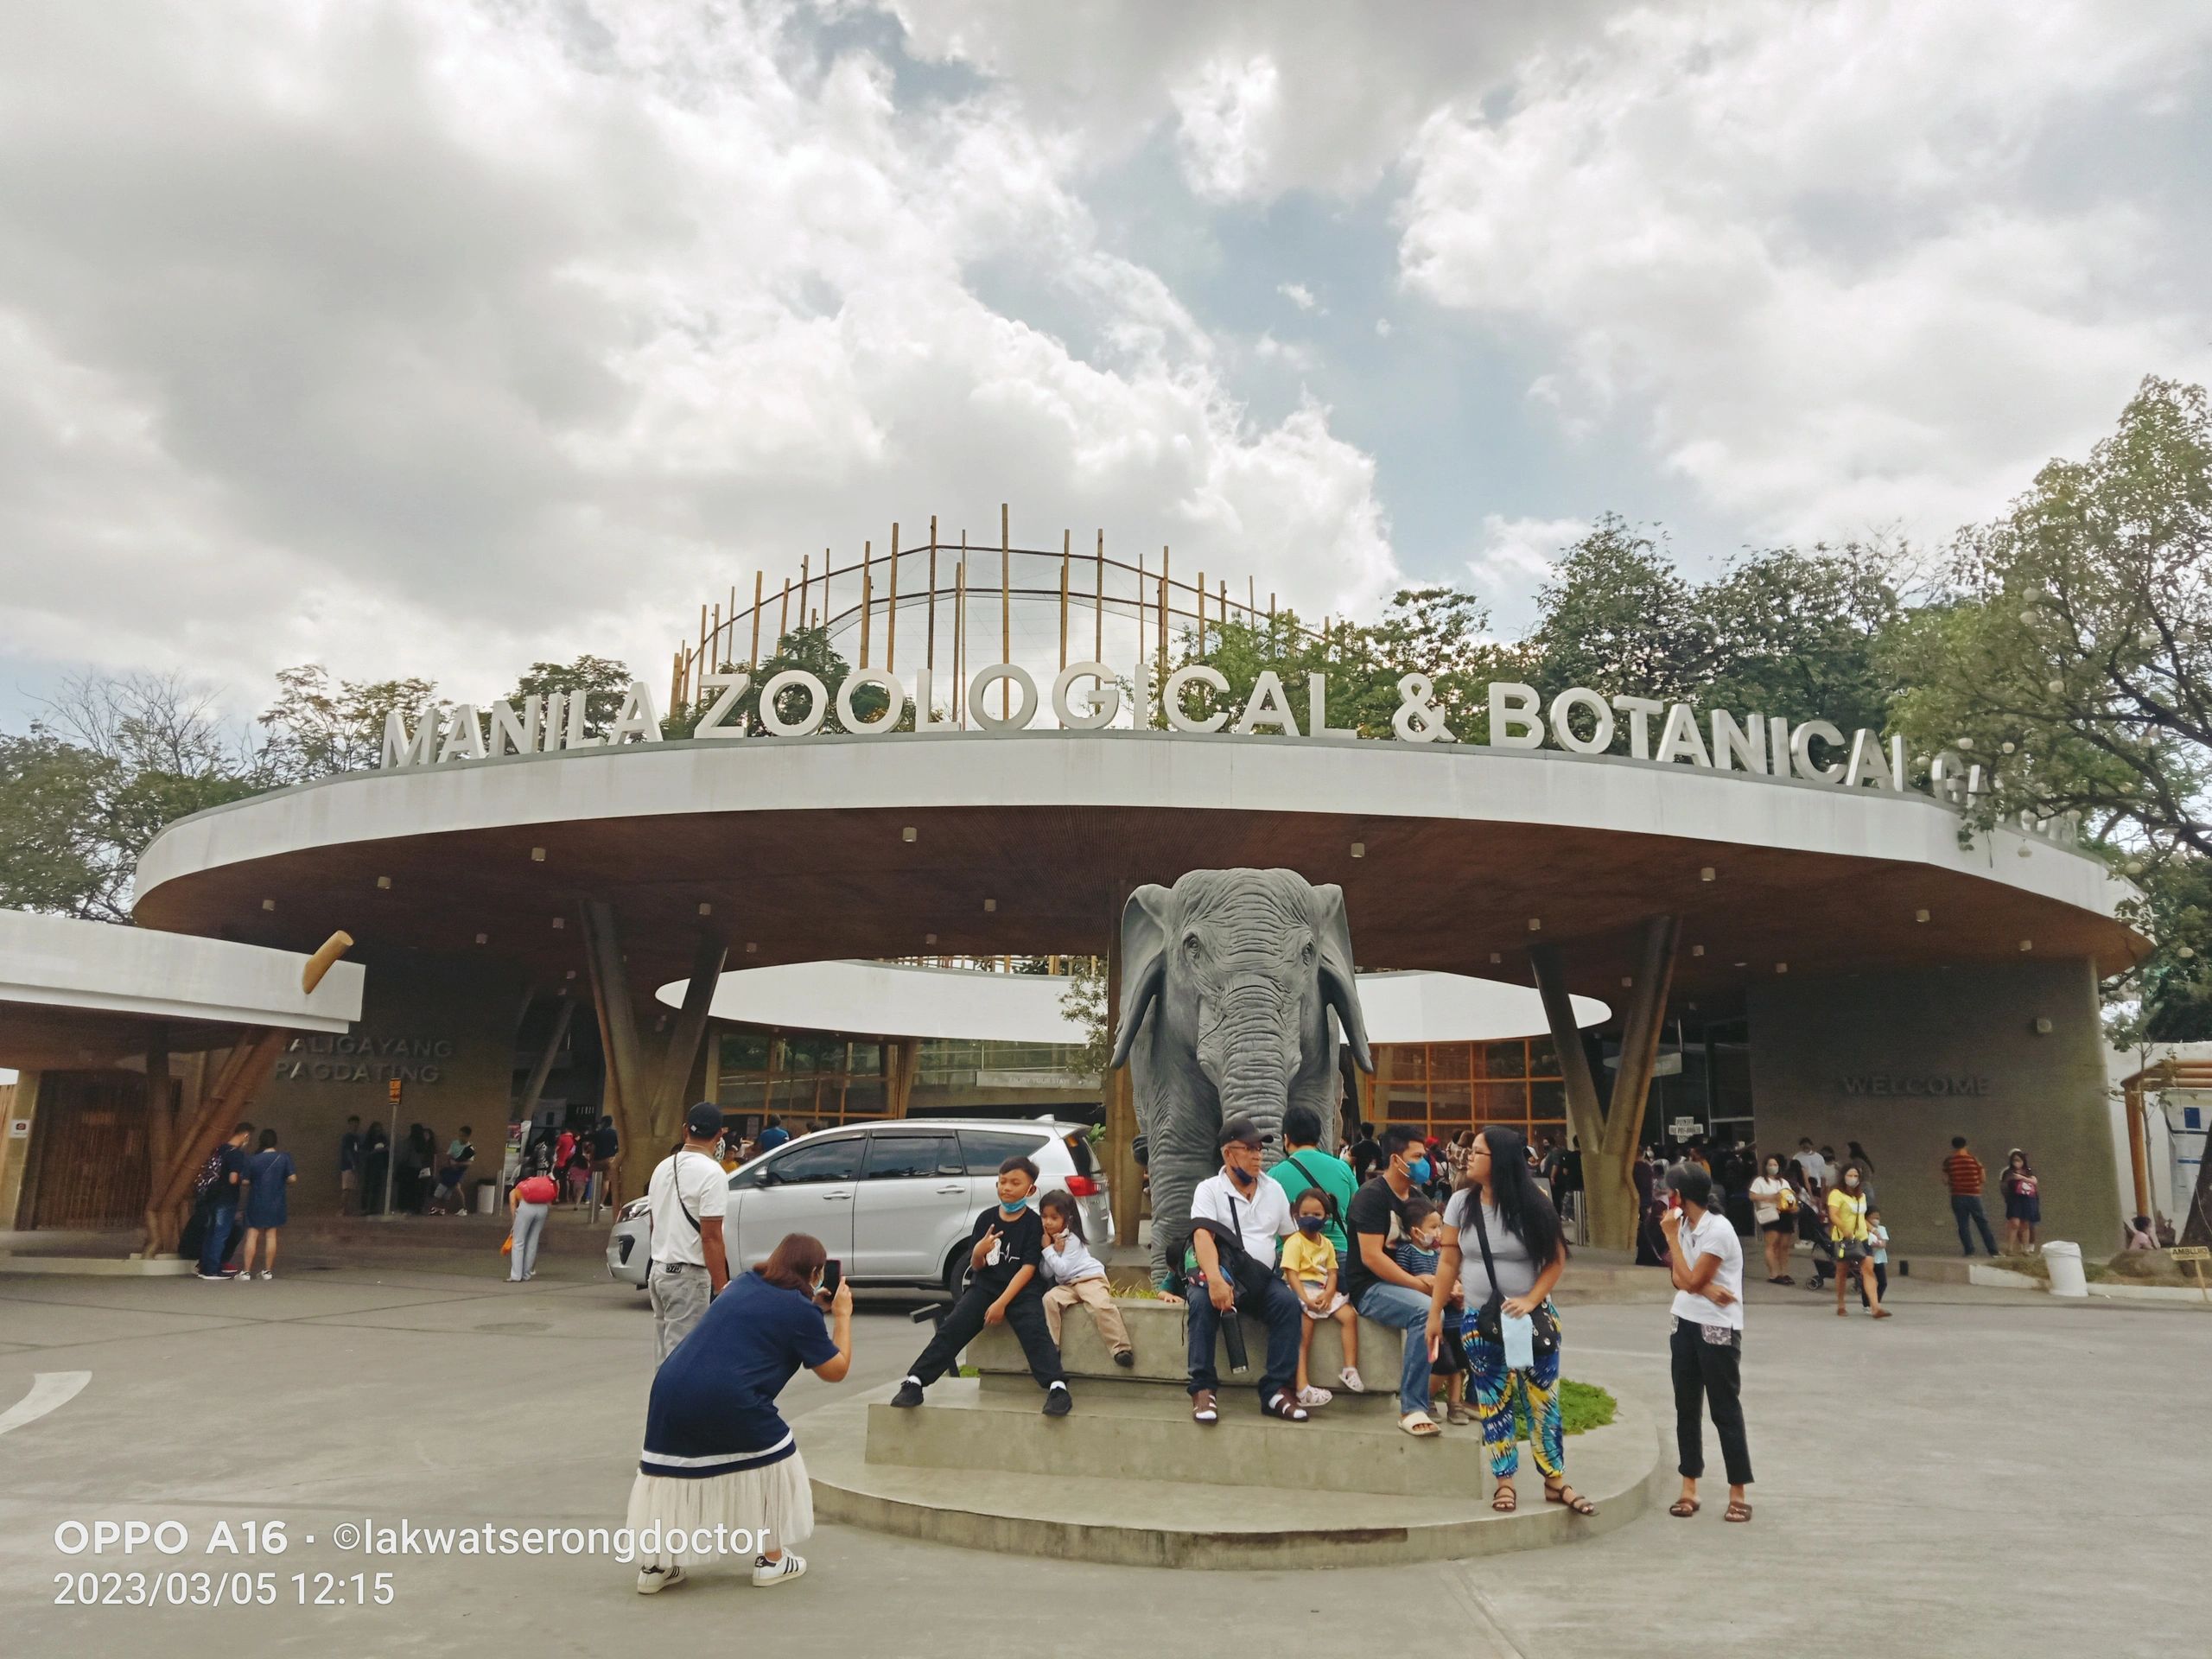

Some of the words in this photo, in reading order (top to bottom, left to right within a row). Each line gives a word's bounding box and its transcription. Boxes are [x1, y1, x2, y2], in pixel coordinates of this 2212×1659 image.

[380, 681, 664, 769] MANILA
[694, 661, 1357, 740] ZOOLOGICAL
[1392, 672, 1456, 743] &
[1488, 681, 1908, 792] BOTANICAL
[283, 1035, 454, 1058] ALIGAYANG
[276, 1059, 442, 1083] PAGDATING
[1842, 1077, 1992, 1095] WELCOME
